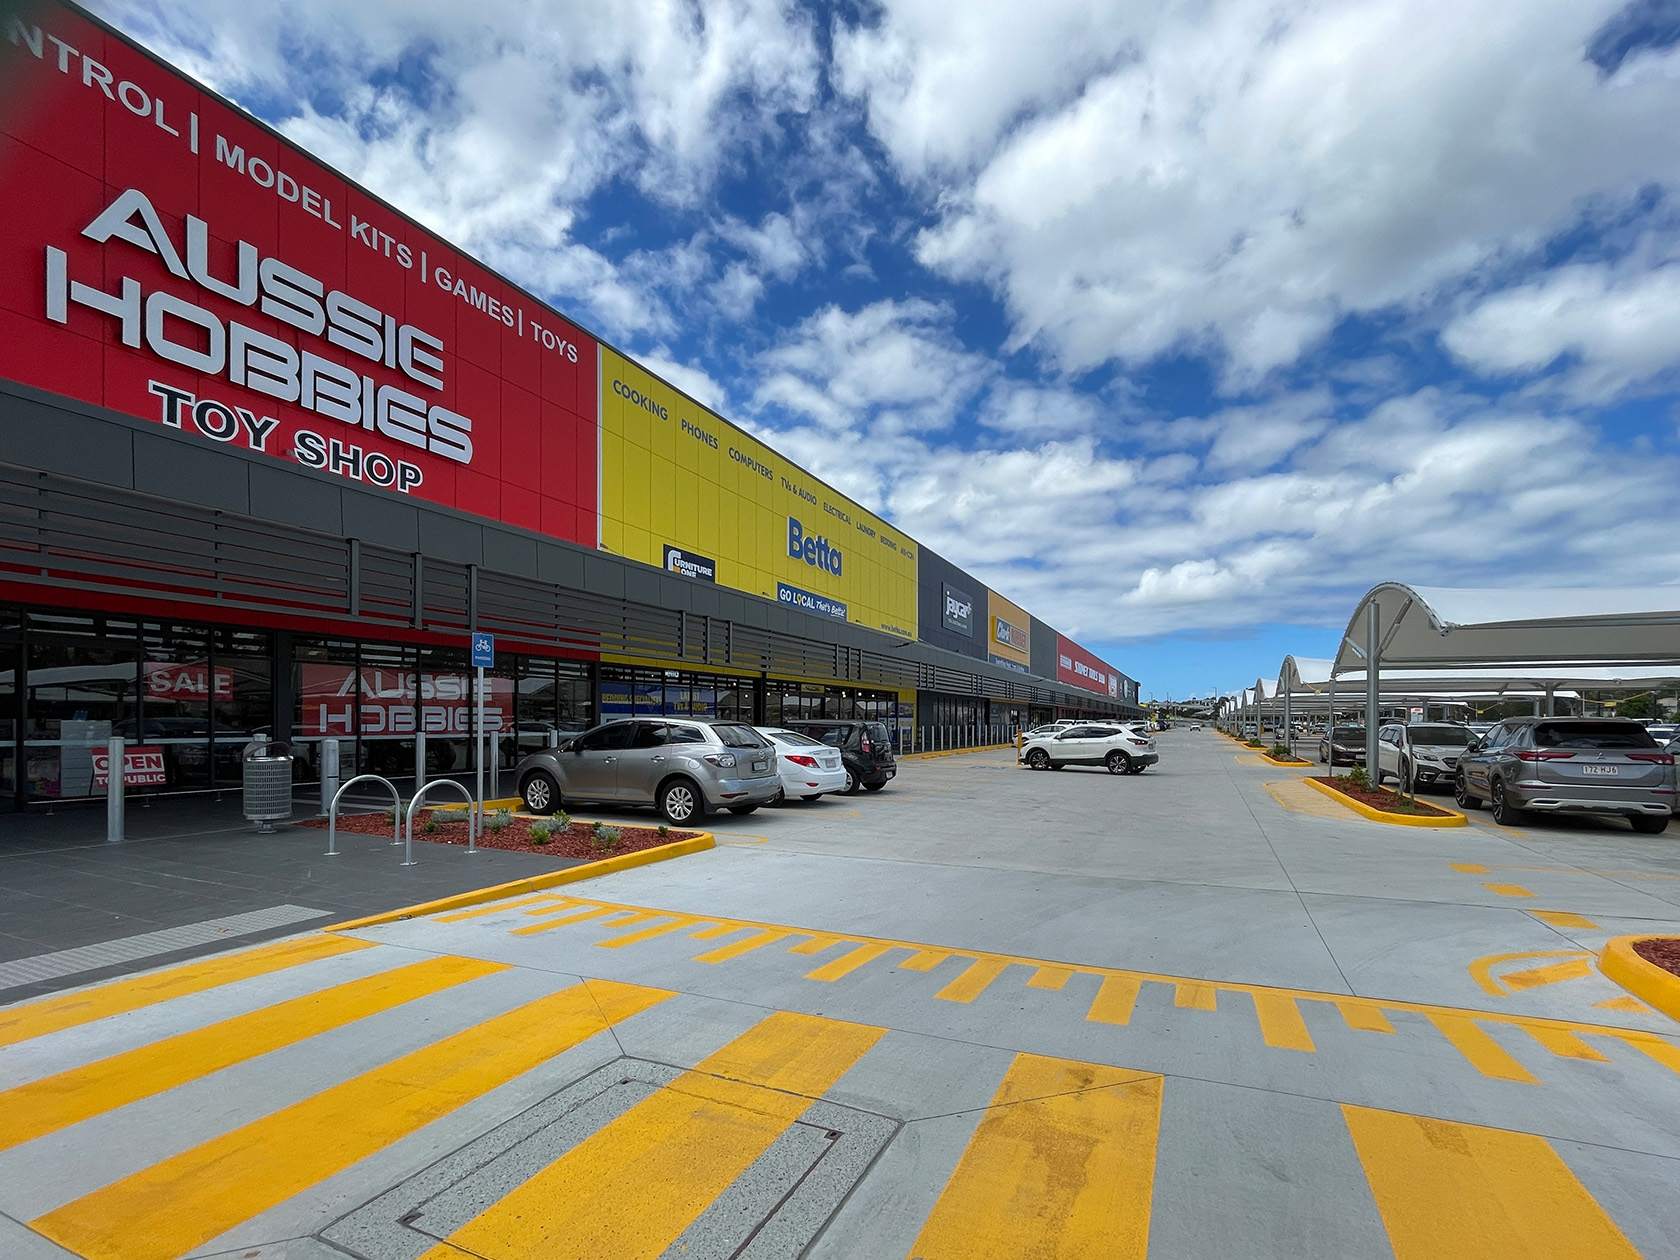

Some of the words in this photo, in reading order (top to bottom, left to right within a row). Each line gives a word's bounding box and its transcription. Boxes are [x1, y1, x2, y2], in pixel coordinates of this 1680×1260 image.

[216, 134, 342, 230] MODEL
[351, 214, 413, 269] KITS
[434, 267, 514, 328] GAMES
[530, 321, 578, 364] TOYS
[81, 188, 444, 391] AUSSIE
[46, 244, 473, 465] HOBBIES
[148, 379, 280, 452] TOY
[293, 429, 423, 493] SHOP
[612, 379, 669, 421] COOKING
[681, 418, 719, 450] PHONES
[728, 446, 774, 481] COMPUTERS
[792, 484, 798, 495] &
[798, 487, 818, 506] AUDIO
[823, 502, 852, 526] ELECTRICAL
[856, 521, 877, 539] LAUNDRY
[786, 515, 843, 577] Betta
[680, 568, 697, 579] ONE
[779, 588, 792, 602] GO
[150, 670, 231, 694] SALE
[336, 668, 492, 701] AUSSIE
[319, 703, 503, 733] HOBBIES
[124, 774, 166, 784] UBLIC
